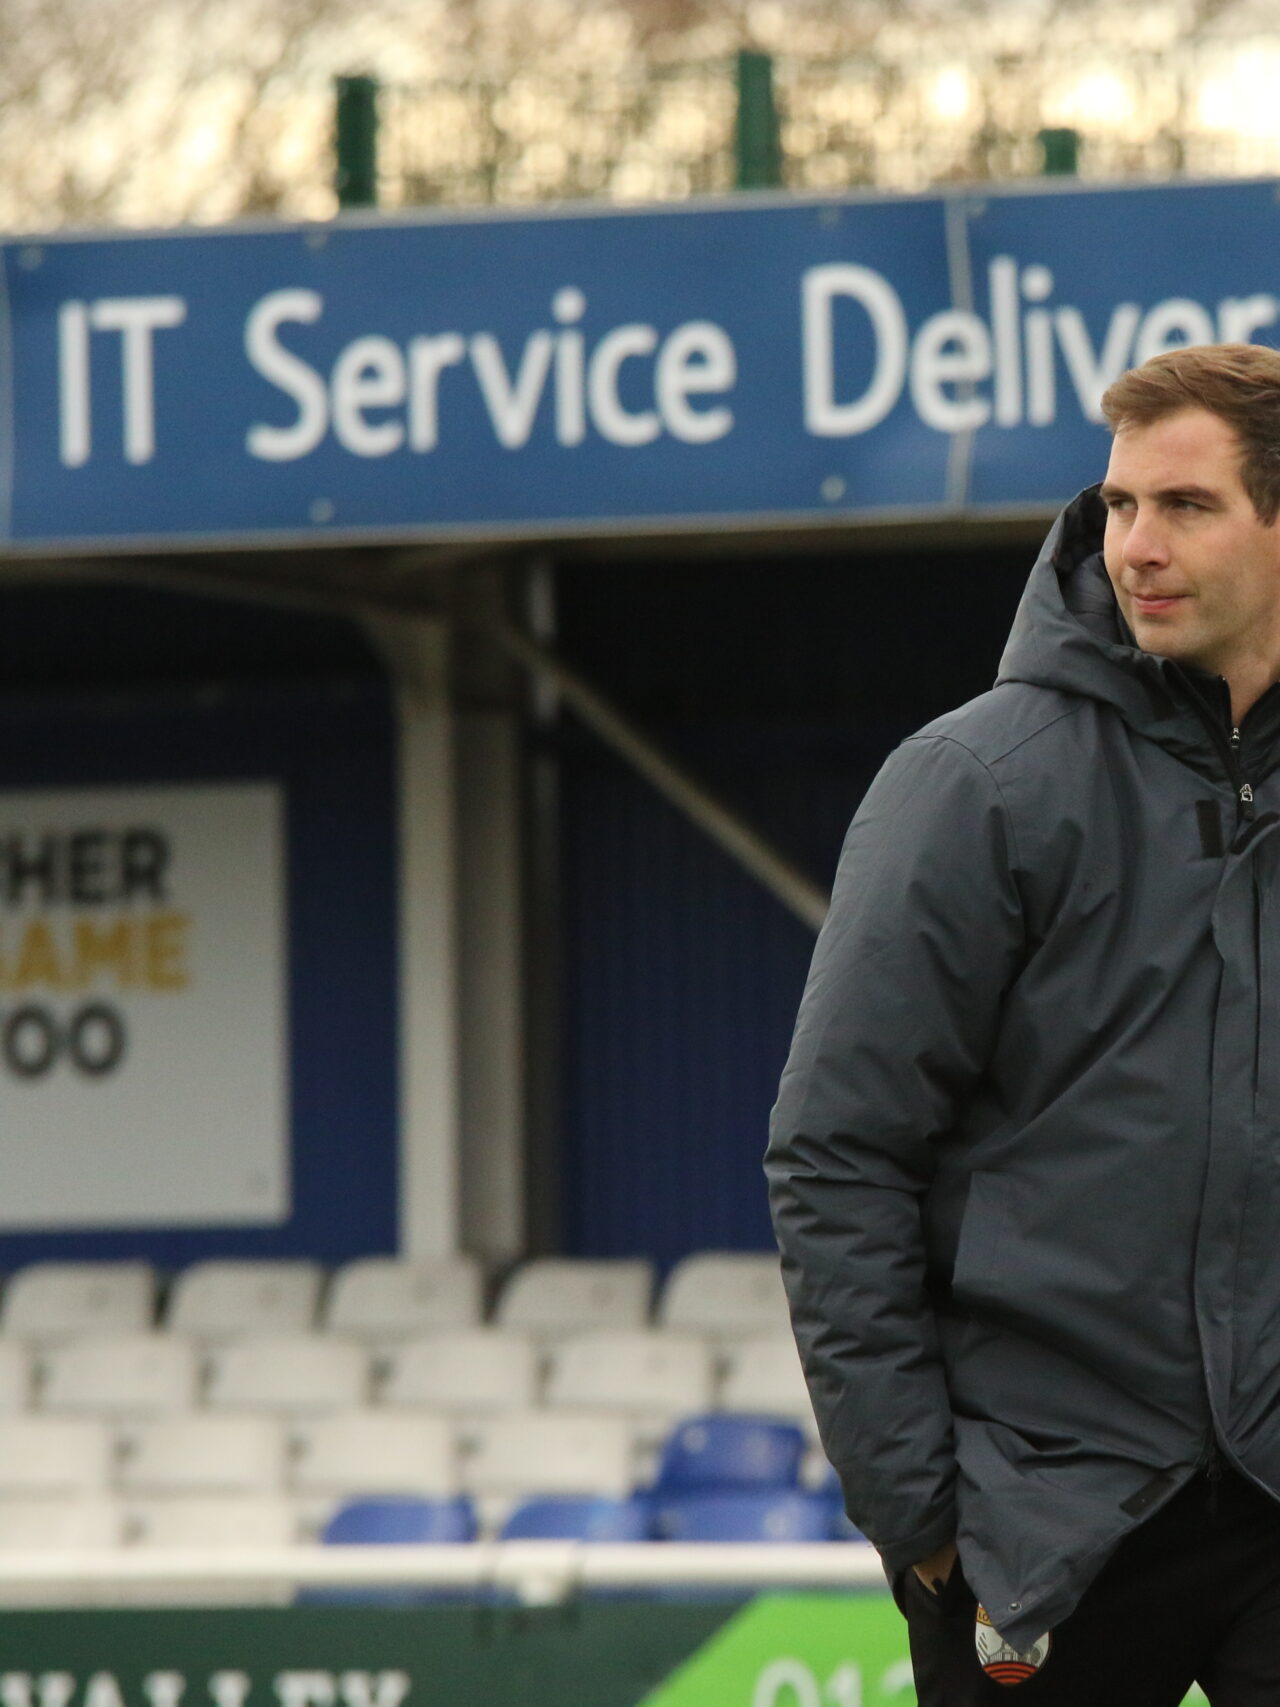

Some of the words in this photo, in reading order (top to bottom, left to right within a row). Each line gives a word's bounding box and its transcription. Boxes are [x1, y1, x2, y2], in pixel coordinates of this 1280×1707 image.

[58, 295, 186, 468] IT
[244, 286, 737, 461] Service
[0, 827, 171, 905] HER
[0, 911, 192, 992] AME
